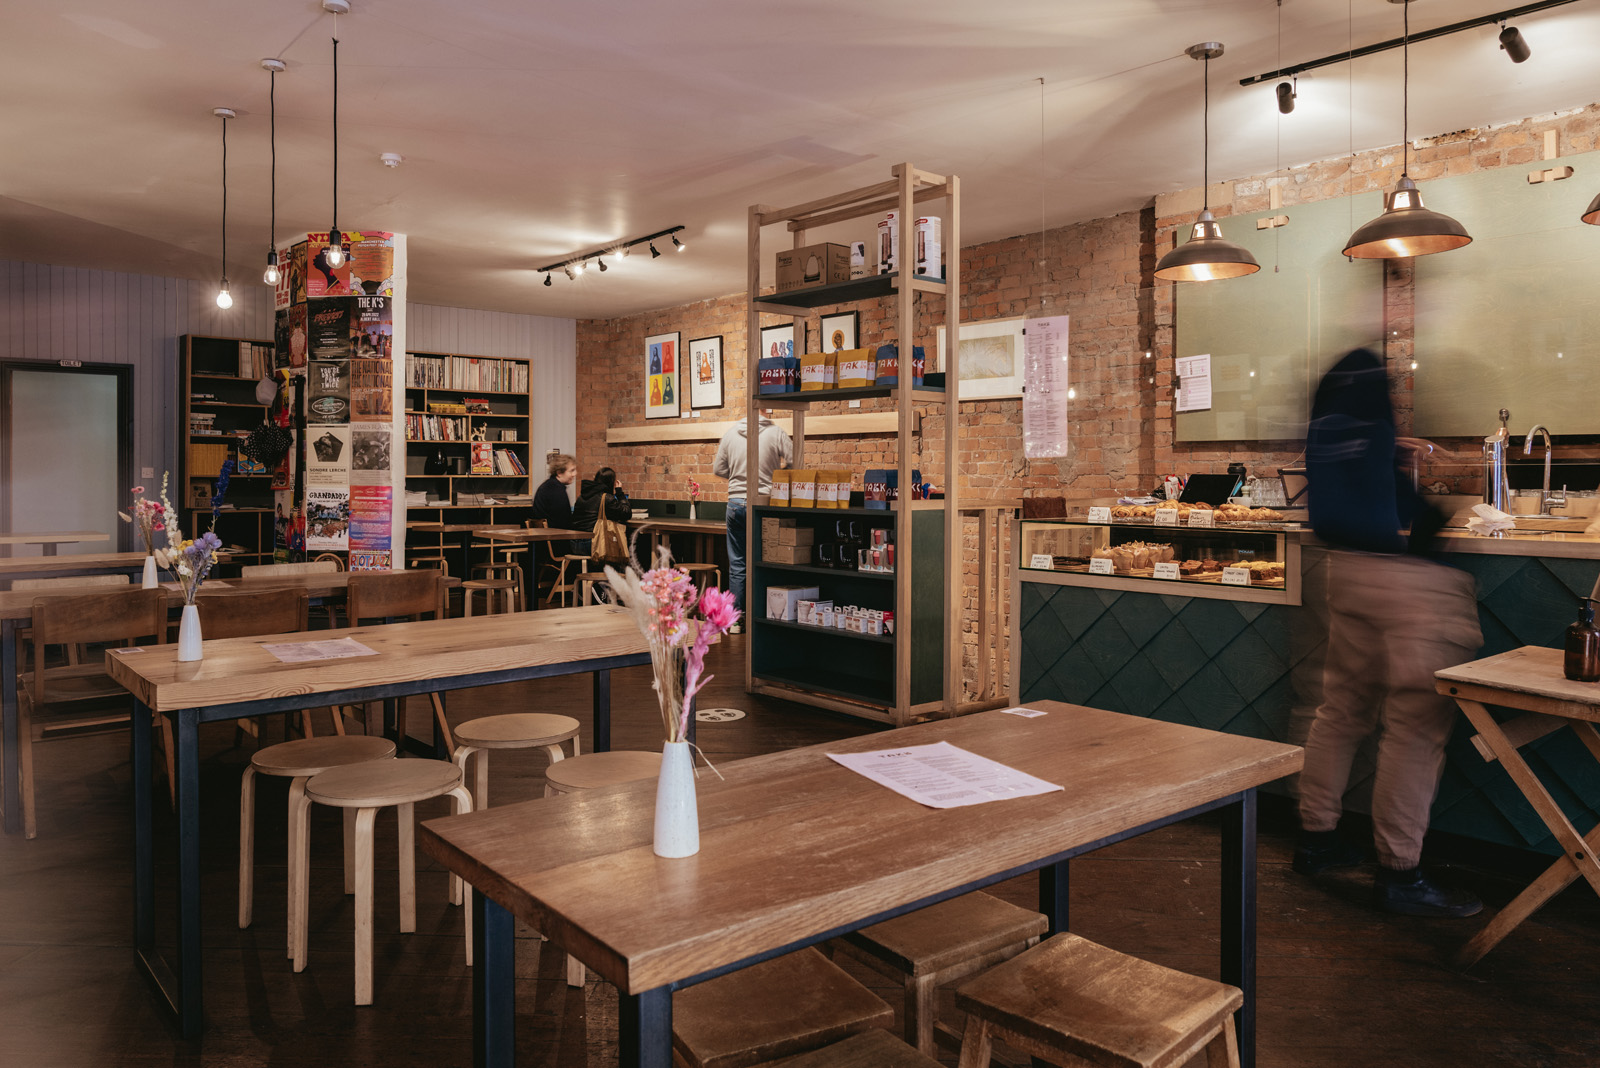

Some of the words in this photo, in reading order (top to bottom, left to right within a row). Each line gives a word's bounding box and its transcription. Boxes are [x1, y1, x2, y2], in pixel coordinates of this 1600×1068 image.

[307, 233, 351, 242] NIA
[357, 297, 370, 308] THE
[371, 297, 384, 308] K'S
[362, 360, 392, 374] NATIONAL
